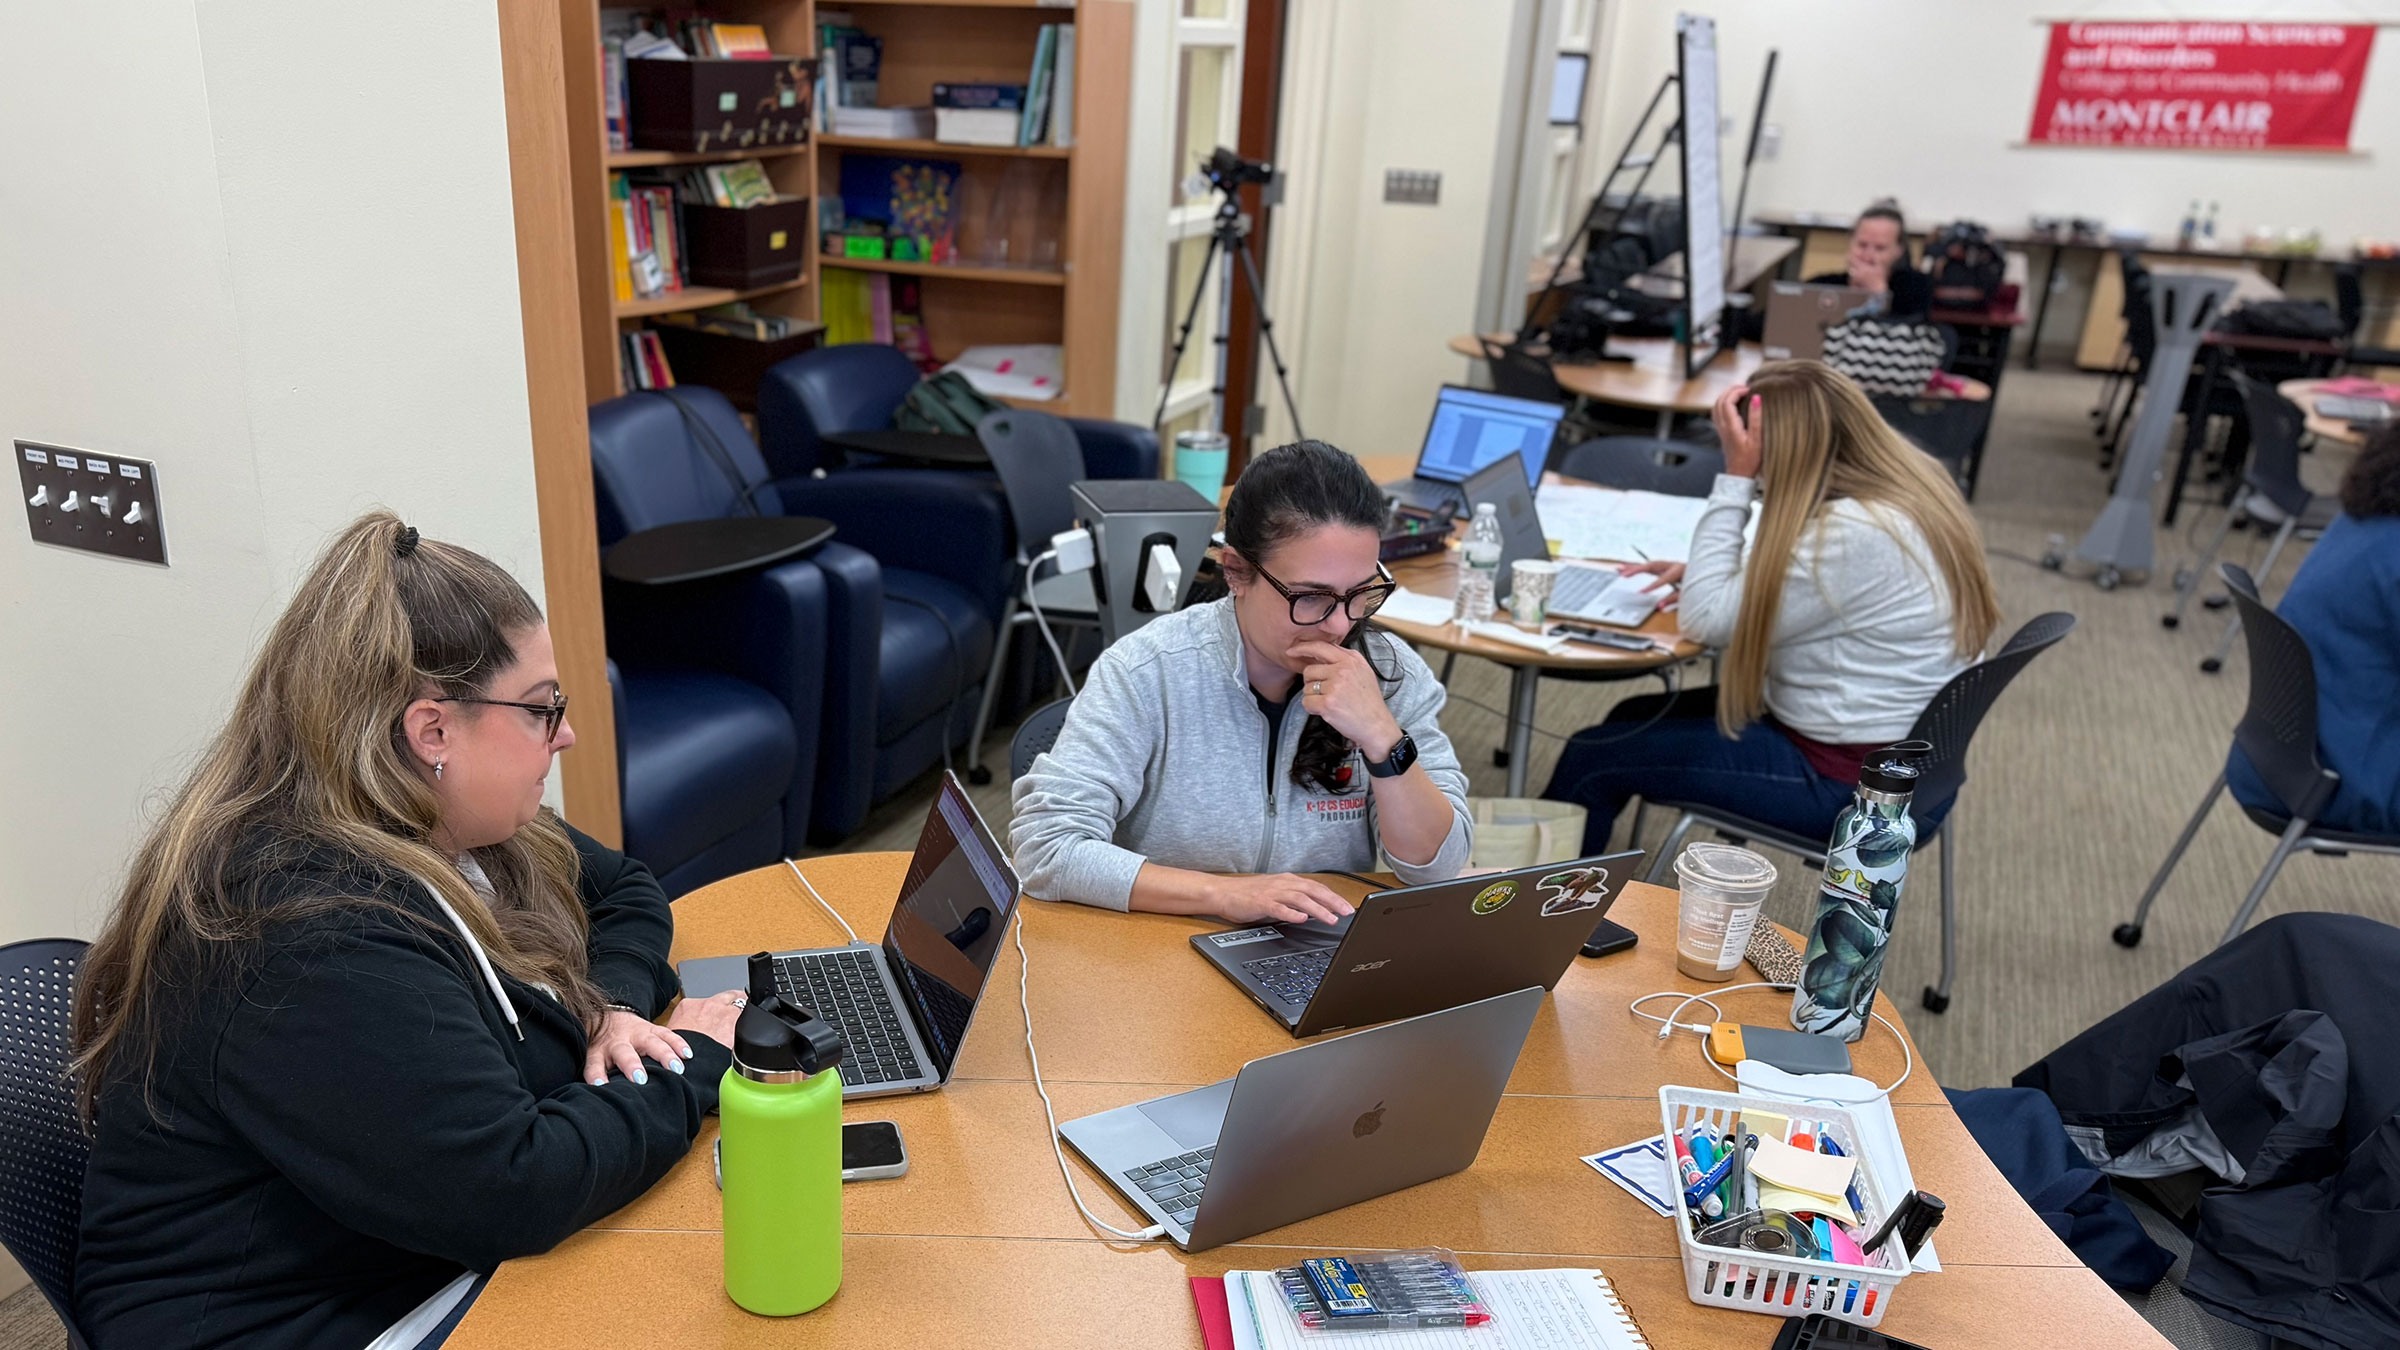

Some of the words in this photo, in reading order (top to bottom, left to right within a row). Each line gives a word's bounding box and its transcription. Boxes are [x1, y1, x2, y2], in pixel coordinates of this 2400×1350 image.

[2050, 99, 2273, 133] MONTCLAIR
[1306, 799, 1326, 812] K-12
[1327, 799, 1338, 811] CS
[1350, 959, 1391, 973] acer
